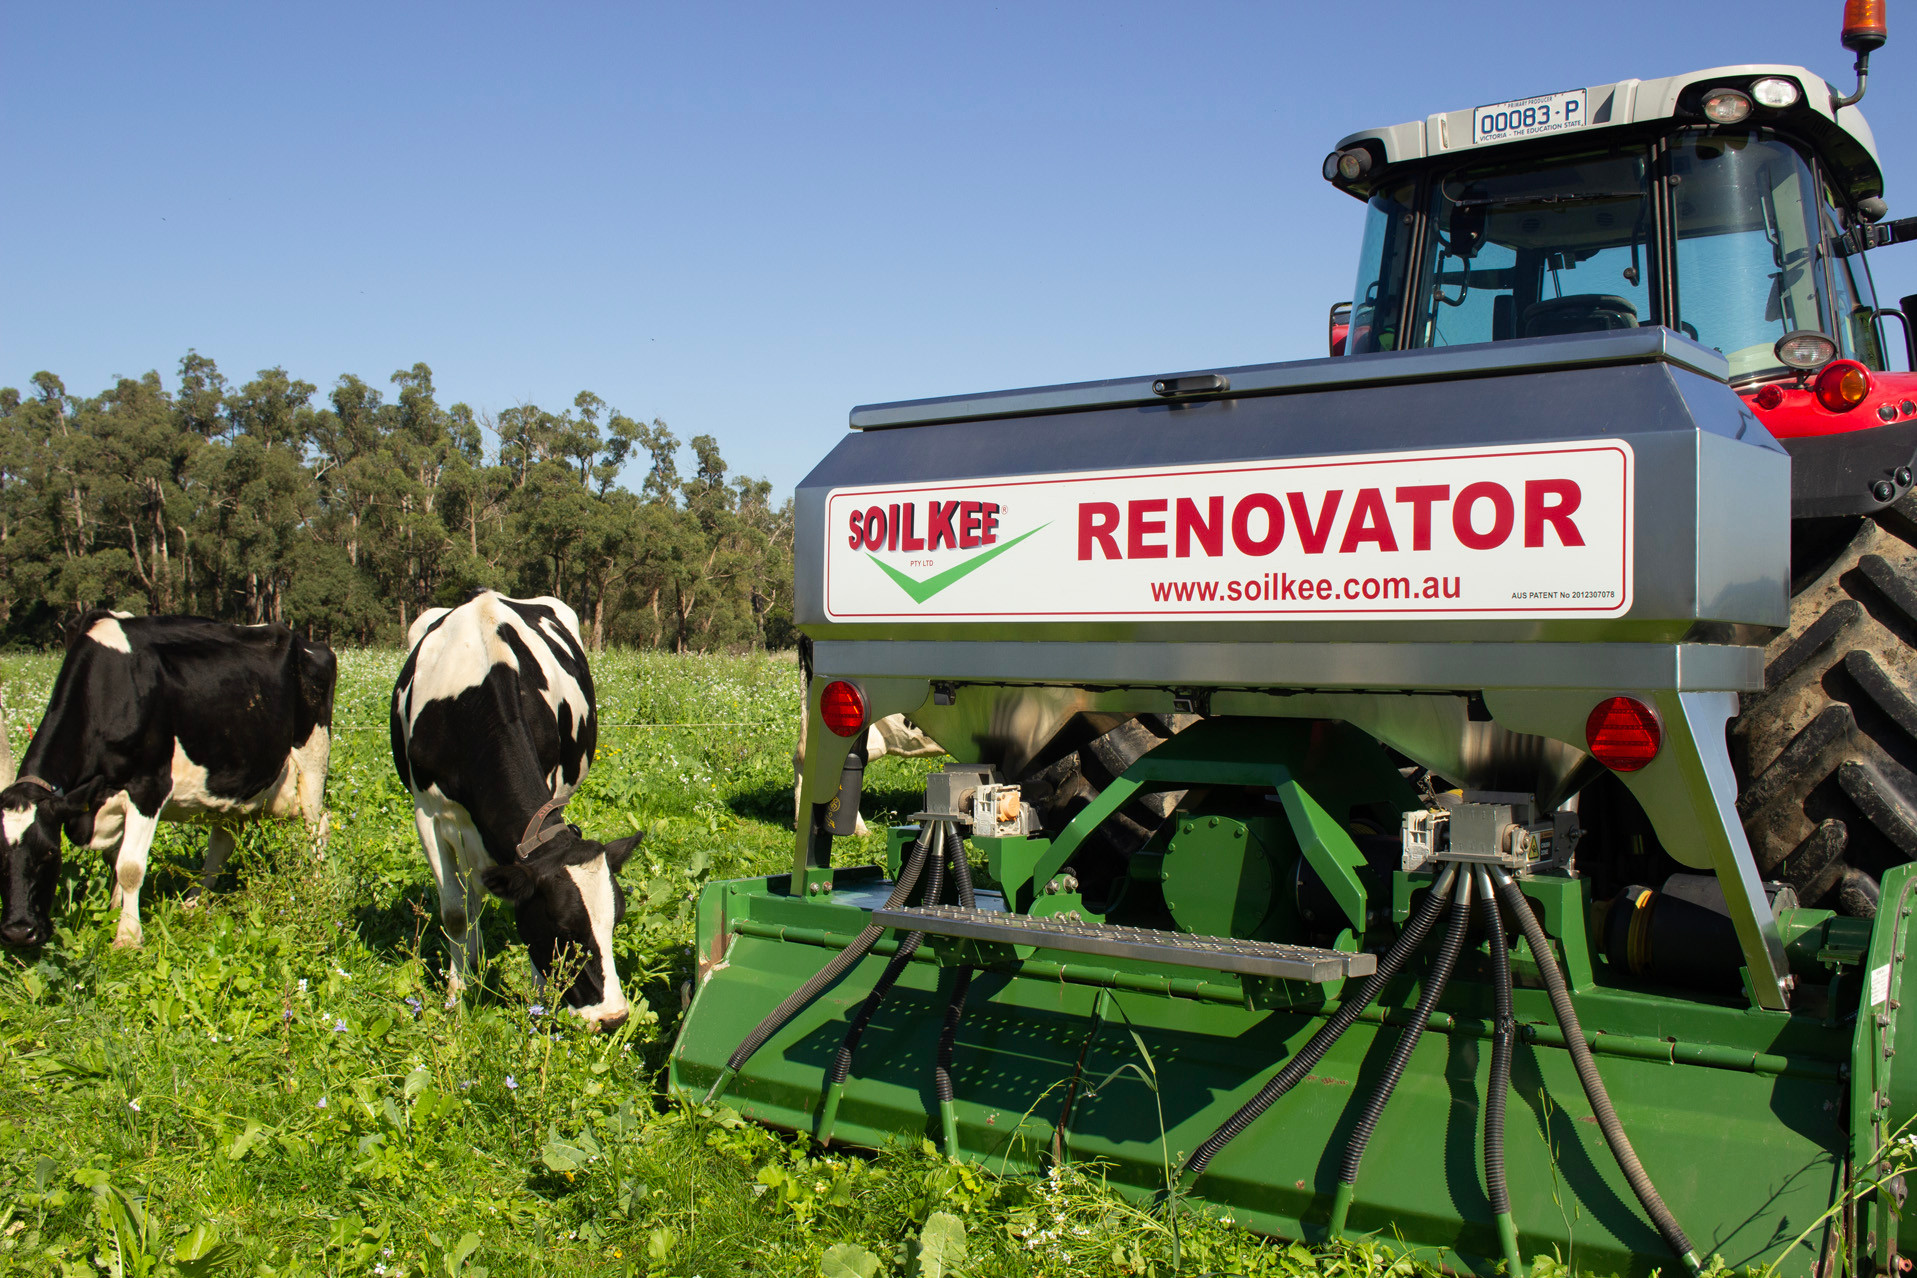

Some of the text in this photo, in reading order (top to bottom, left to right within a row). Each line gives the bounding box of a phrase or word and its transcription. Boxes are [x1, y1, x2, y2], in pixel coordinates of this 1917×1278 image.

[1507, 96, 1553, 109] PRIMARY PRODUCER
[1480, 132, 1507, 142] VICTORIA
[1513, 129, 1525, 137] THE
[1526, 123, 1563, 135] EDUCATION
[1563, 120, 1582, 129] STATE
[848, 500, 1000, 552] SOILKEE
[1077, 478, 1586, 561] RENOVATOR
[922, 559, 934, 567] LTD
[1150, 571, 1461, 602] www.soilkee.com.au
[1529, 591, 1558, 599] PATENT
[1559, 591, 1571, 599] No
[1571, 591, 1615, 599] 2012307078
